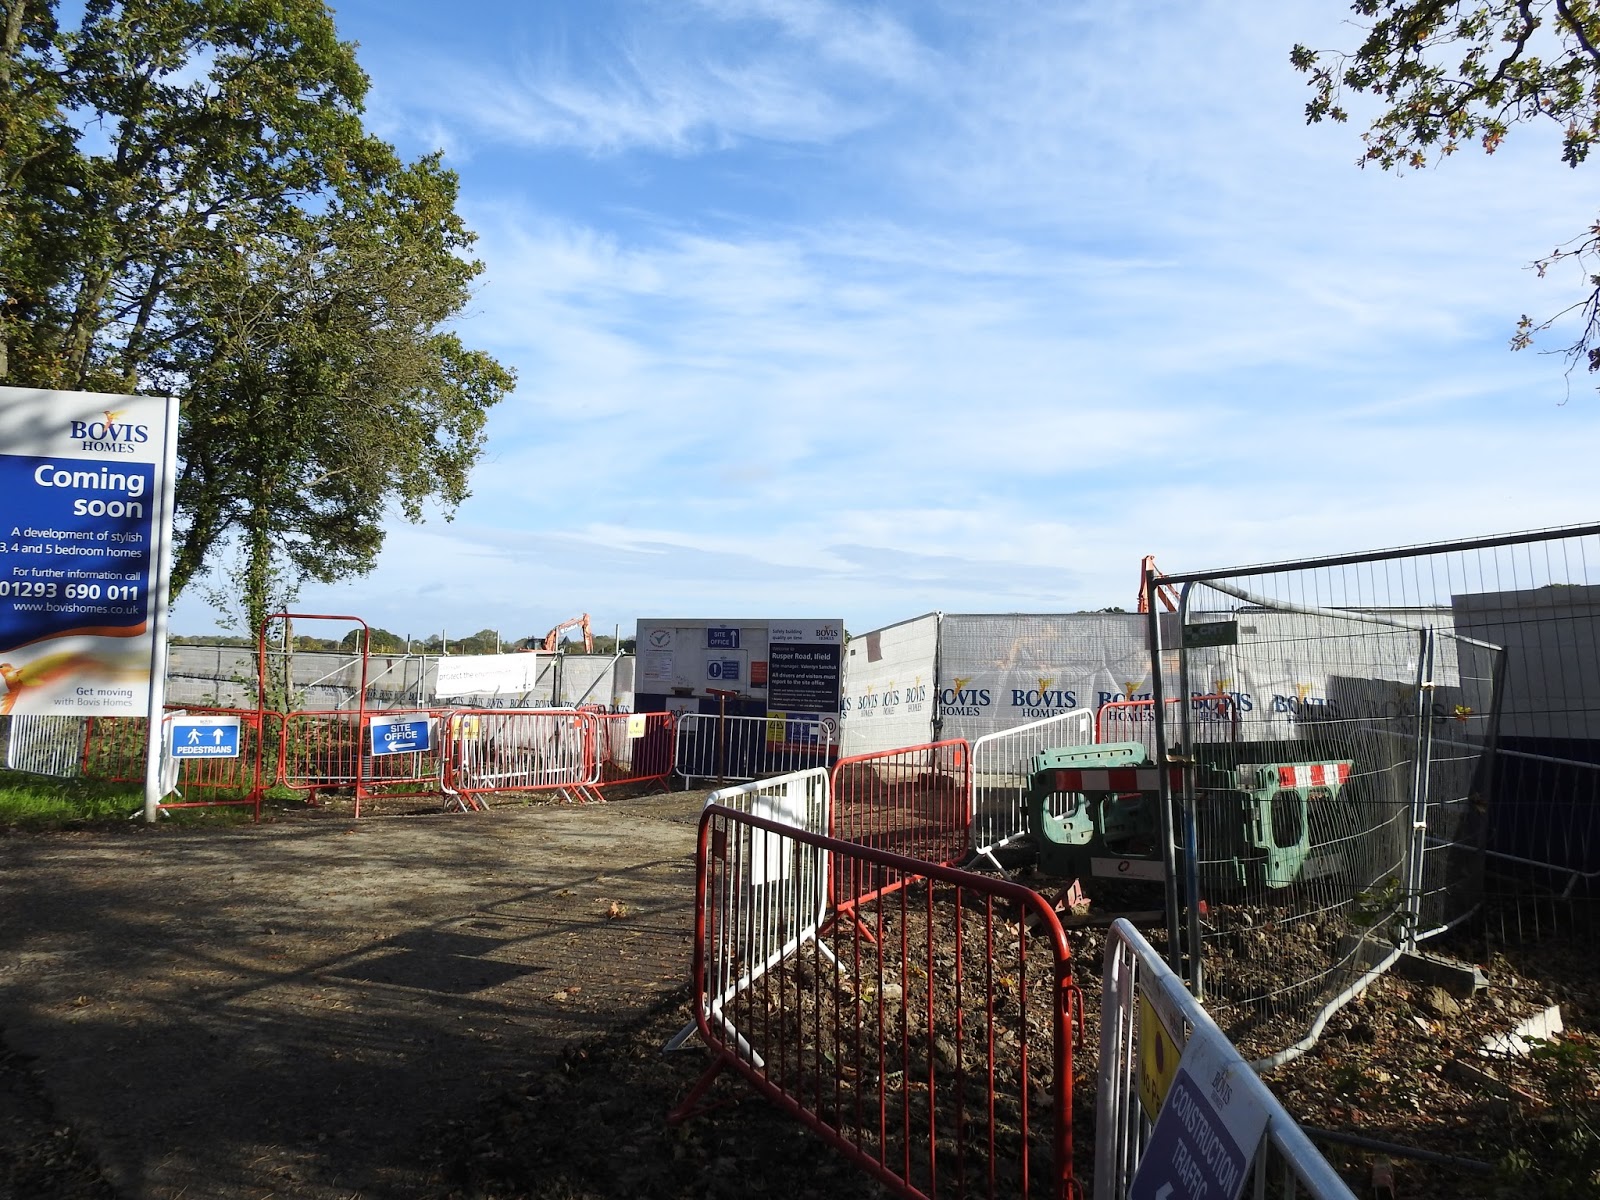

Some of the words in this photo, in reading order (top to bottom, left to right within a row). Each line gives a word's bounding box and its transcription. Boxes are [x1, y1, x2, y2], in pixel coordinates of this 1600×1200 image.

[70, 420, 148, 443] BOVIS
[82, 441, 135, 453] HOMES
[34, 464, 145, 497] Coming
[73, 499, 143, 518] soon
[11, 527, 21, 537] A
[24, 527, 94, 541] development
[97, 531, 109, 541] of
[111, 532, 143, 543] stylish
[11, 543, 19, 553] 4
[22, 544, 43, 554] and
[45, 545, 53, 554] 5
[55, 545, 104, 556] bedroom
[106, 547, 142, 558] homes
[13, 567, 29, 576] For
[31, 568, 65, 578] further
[67, 569, 122, 580] information
[125, 572, 141, 581] call
[0, 581, 57, 598] 01293
[65, 584, 100, 600] 690
[107, 586, 138, 600] 011
[13, 602, 139, 615] www.bovishomes.co.uk
[816, 629, 838, 637] BOVIS
[772, 652, 793, 661] Rusper
[794, 653, 813, 661] Road,
[76, 687, 93, 696] Get
[97, 688, 133, 697] moving
[1011, 689, 1077, 708] BOVIS
[54, 697, 74, 706] with
[77, 698, 100, 706] Bovis
[103, 698, 133, 706] Homes
[1097, 691, 1155, 711] BOVI
[940, 706, 980, 716] HOMES
[1022, 708, 1065, 717] HOMES
[1108, 711, 1155, 722] HOMES
[384, 730, 417, 740] OFFICE
[390, 724, 411, 733] SITE
[177, 746, 232, 755] PEDESTRIANS
[1212, 1070, 1233, 1105] BOVIS
[1171, 1084, 1239, 1198] CONSTRUCTION
[1171, 1137, 1208, 1200] TRAFFIC
